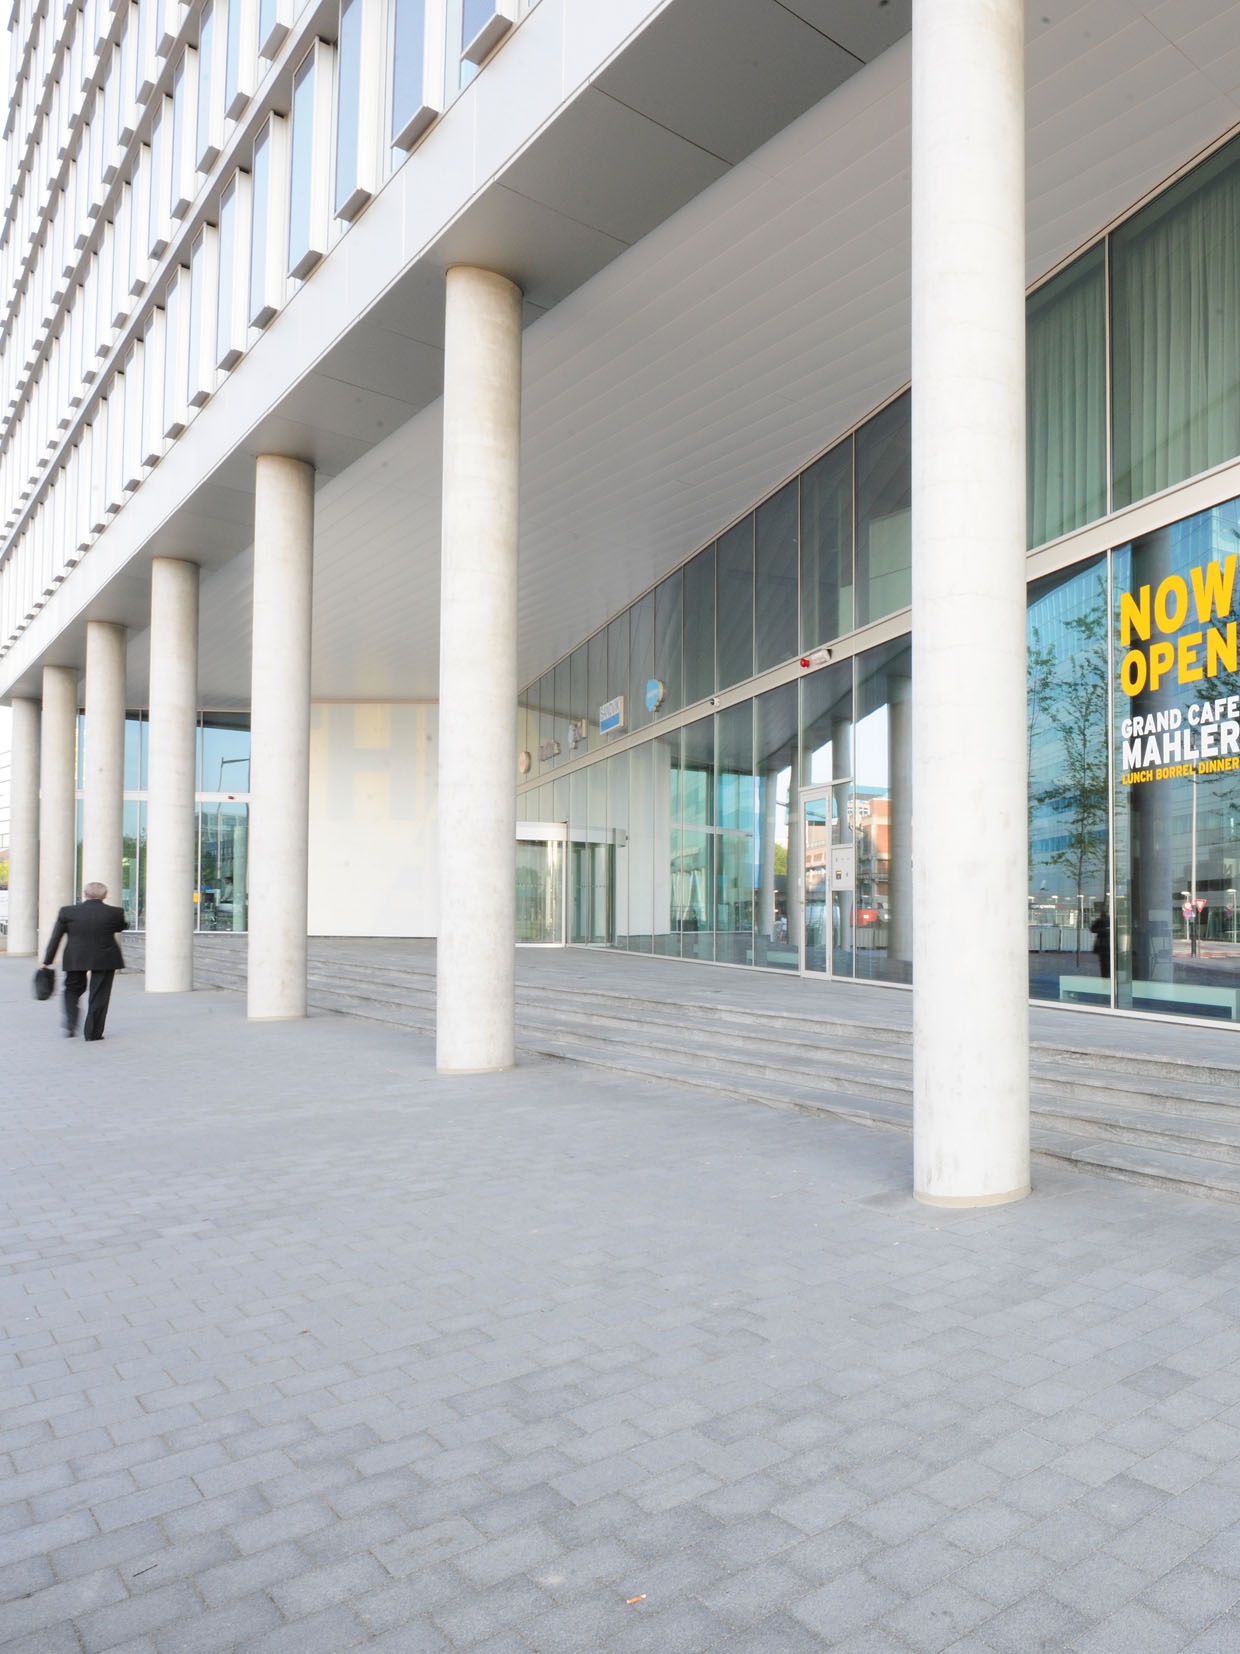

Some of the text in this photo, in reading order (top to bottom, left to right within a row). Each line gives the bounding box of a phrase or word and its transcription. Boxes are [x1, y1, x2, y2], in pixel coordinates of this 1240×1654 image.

[1120, 553, 1238, 647] NOW
[1120, 621, 1238, 697] OPEN
[1121, 695, 1240, 739] GRAND CAFE
[1122, 720, 1240, 770] MAHLER
[1121, 756, 1240, 785] LUNCH BORREL DINNER
